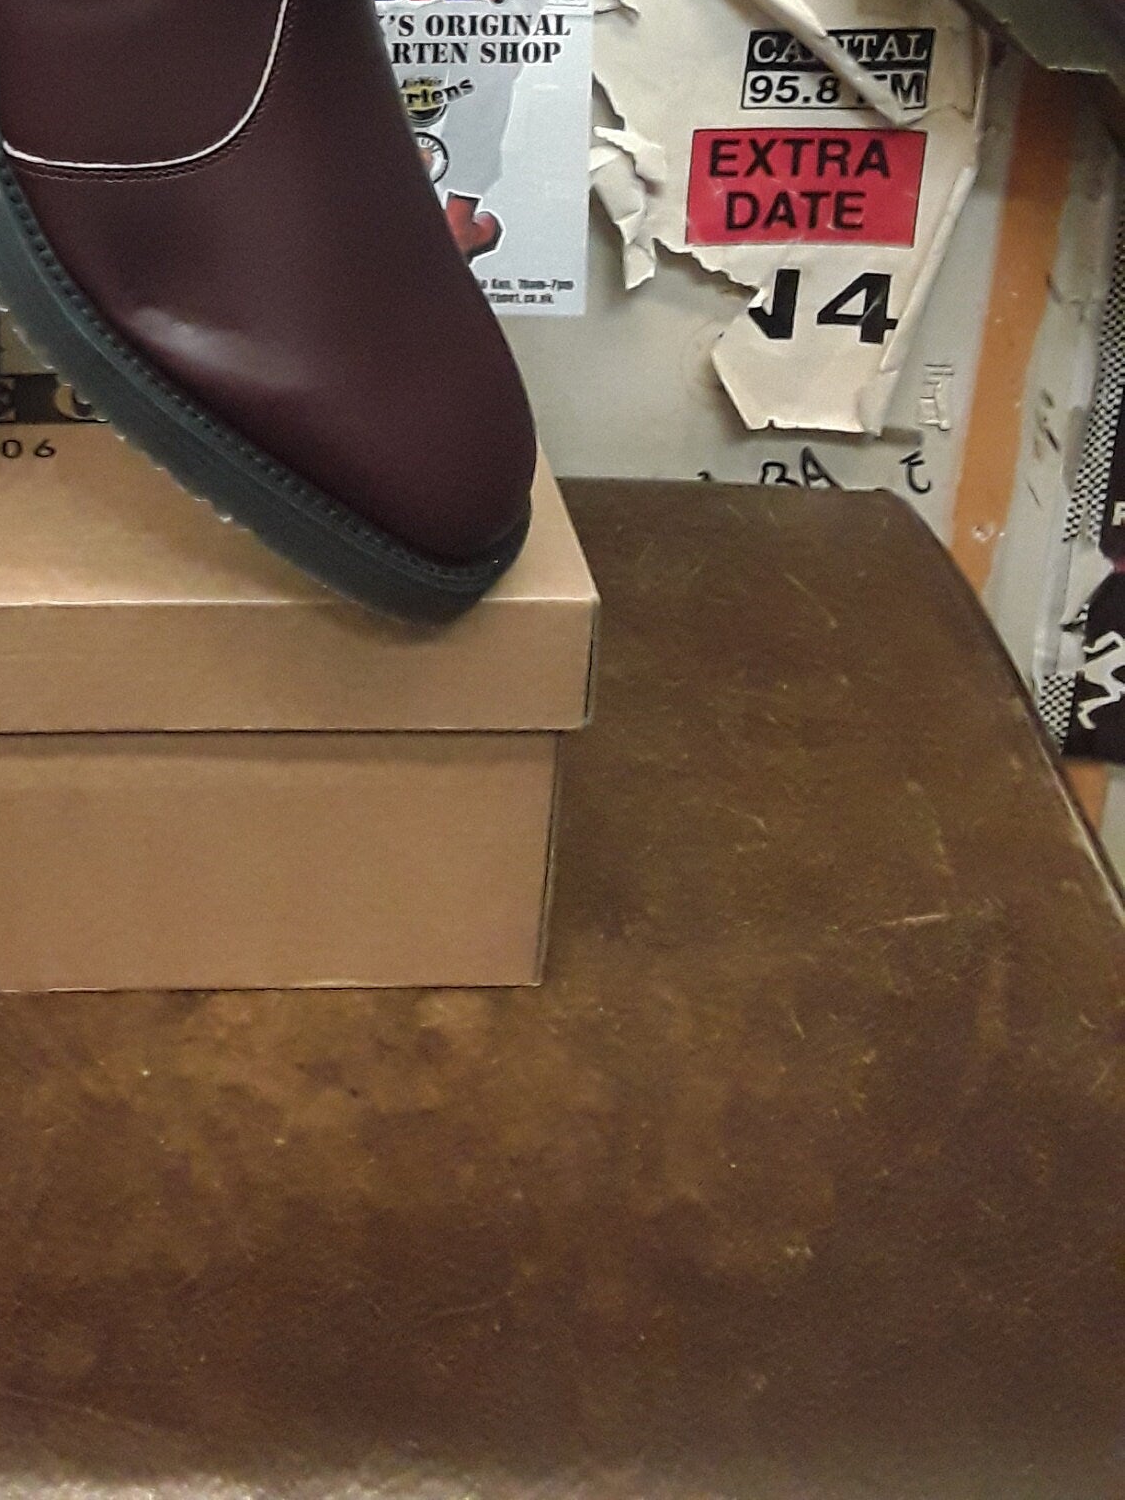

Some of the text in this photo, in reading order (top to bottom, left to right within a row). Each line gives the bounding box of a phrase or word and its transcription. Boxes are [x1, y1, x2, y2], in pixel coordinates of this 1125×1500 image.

[425, 14, 572, 37] ORIGINAL
[391, 41, 562, 64] RTEN SHOP
[406, 77, 475, 105] rtens
[749, 74, 840, 104] 95.8
[709, 138, 891, 178] EXTRA
[726, 191, 867, 231] DATE
